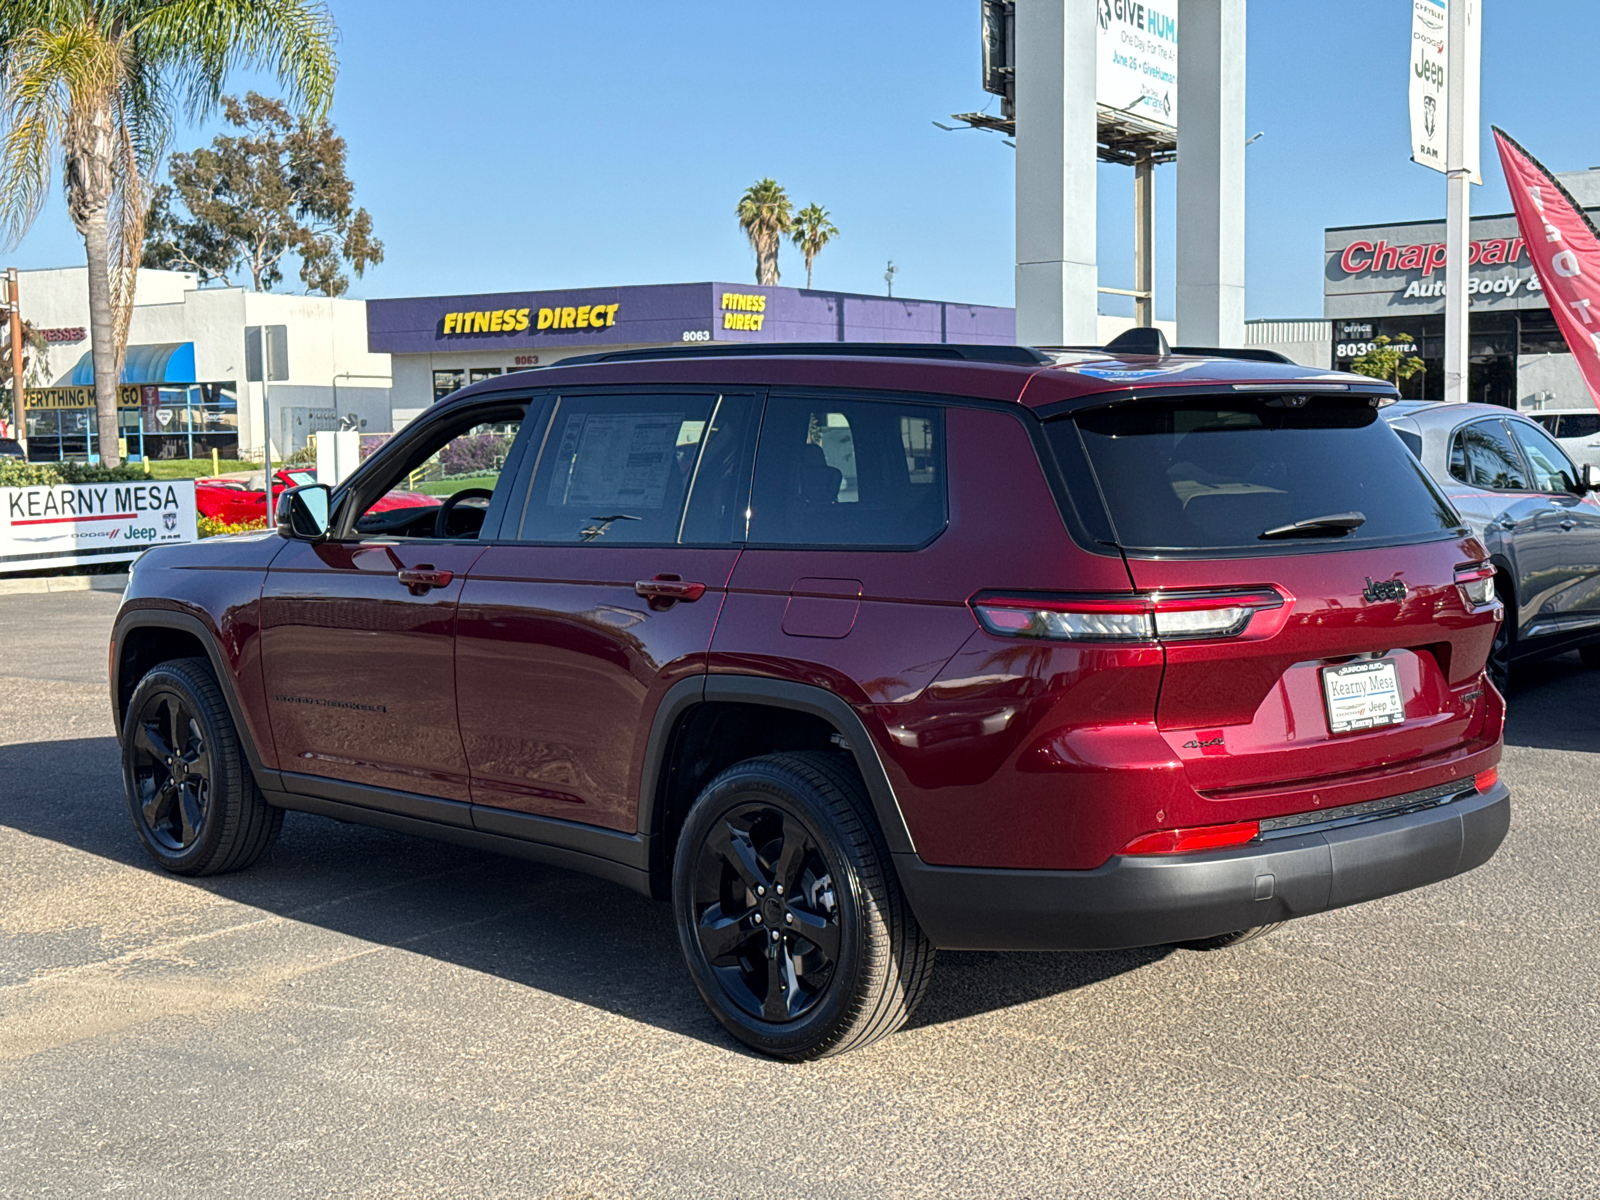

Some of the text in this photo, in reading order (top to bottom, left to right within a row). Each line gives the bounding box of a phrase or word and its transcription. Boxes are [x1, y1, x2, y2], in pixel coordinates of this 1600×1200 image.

[1114, 0, 1178, 44] GIVE HUM
[1121, 29, 1133, 46] One
[1112, 49, 1128, 67] June
[1414, 47, 1444, 93] Jeep
[1420, 144, 1439, 159] RAM
[1467, 274, 1522, 297] Body
[721, 292, 766, 312] FITNESS
[443, 303, 619, 335] FITNESS DIRECT
[723, 312, 764, 331] DIRECT
[37, 327, 87, 342] RESSES
[682, 330, 710, 341] 8063
[1343, 324, 1372, 333] OFFICE
[1336, 342, 1377, 357] 8039
[514, 355, 539, 365] 8063
[24, 389, 85, 408] VERYTHING
[121, 387, 139, 405] GO
[9, 485, 179, 518] KEARNY MESA
[123, 525, 157, 541] Jeep
[1362, 576, 1409, 604] Jeep
[1330, 675, 1395, 698] Kearny Mesa
[1368, 701, 1387, 712] Jeep
